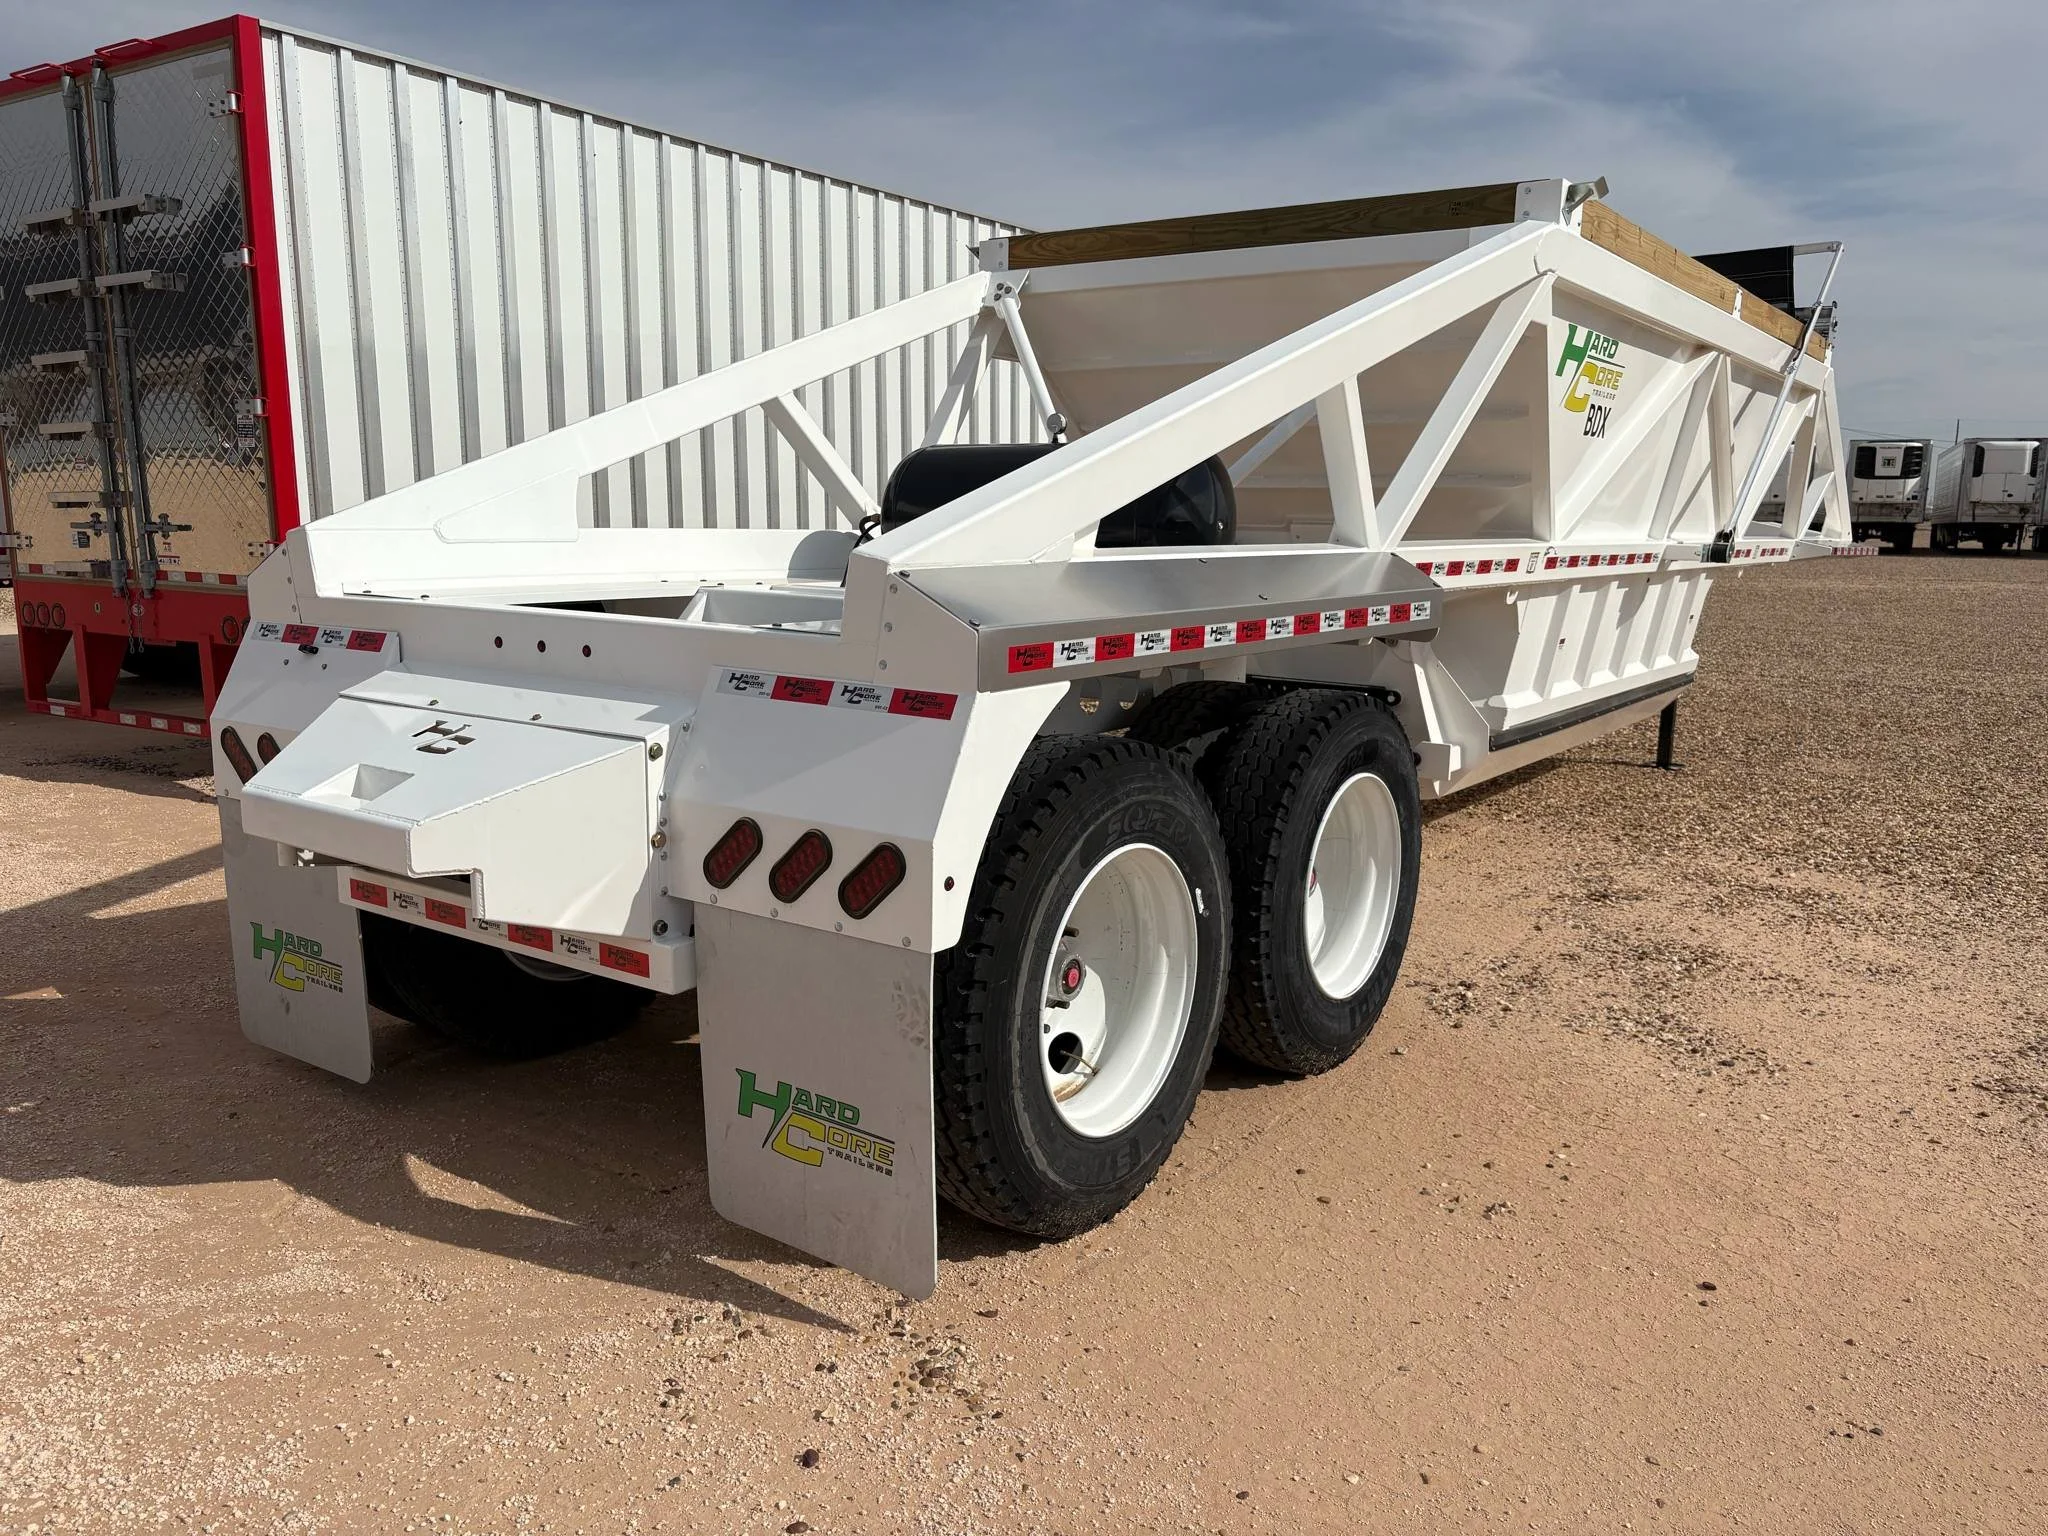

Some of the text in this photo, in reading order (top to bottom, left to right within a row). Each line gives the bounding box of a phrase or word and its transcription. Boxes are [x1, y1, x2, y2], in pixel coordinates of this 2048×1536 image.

[1555, 323, 1619, 407] HARD
[1563, 361, 1624, 413] CORE
[1583, 403, 1612, 439] BDX
[249, 922, 323, 983] HARD
[274, 951, 343, 993] CORE
[735, 1068, 860, 1149] HARD
[771, 1112, 895, 1168] CORE
[827, 1146, 893, 1177] TRAILERS
